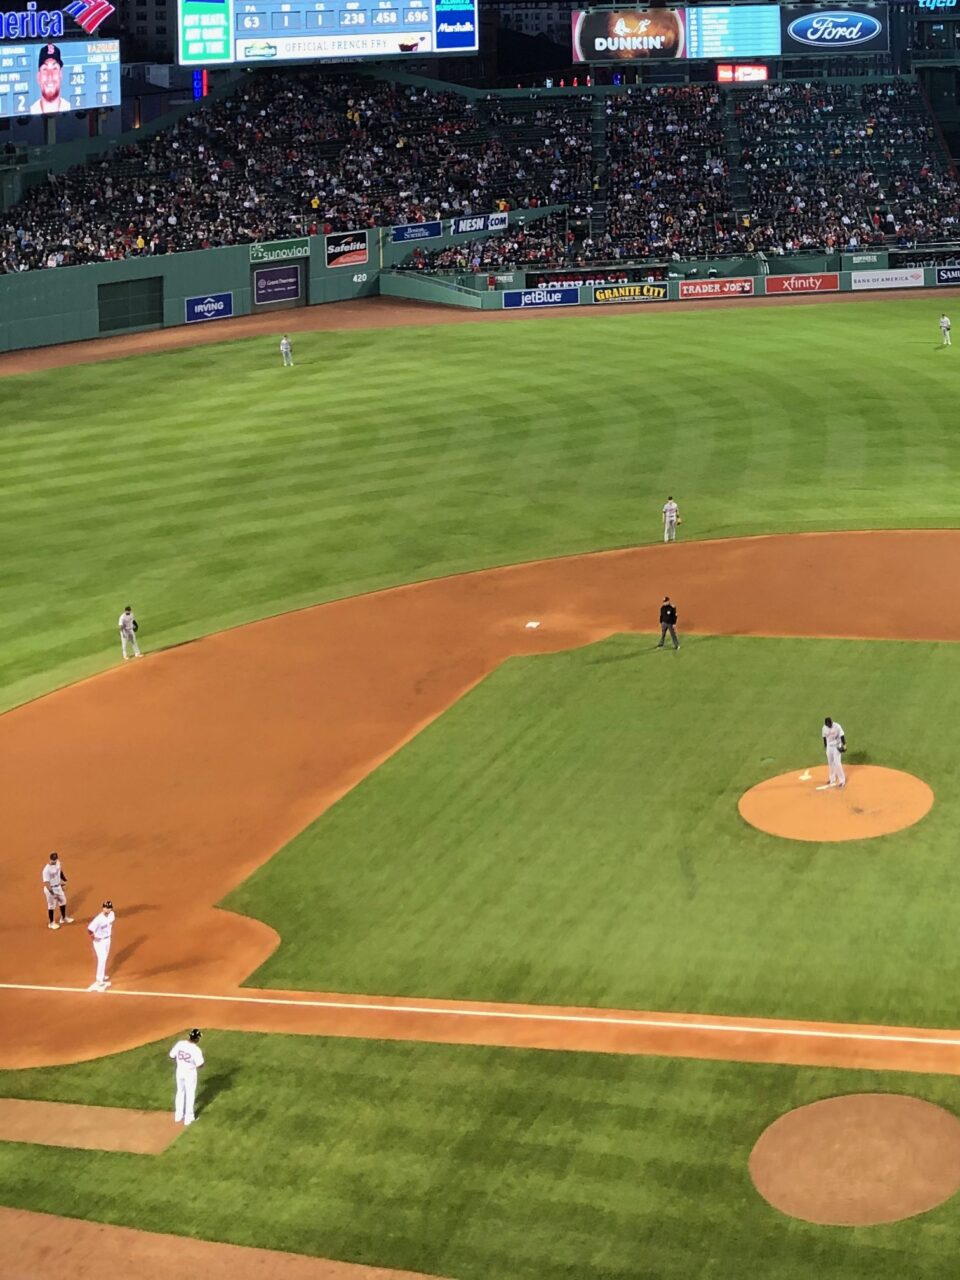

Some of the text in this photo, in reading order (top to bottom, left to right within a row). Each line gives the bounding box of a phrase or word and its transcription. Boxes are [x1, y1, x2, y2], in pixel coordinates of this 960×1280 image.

[244, 16, 260, 28] 63
[340, 13, 365, 25] .238
[372, 12, 397, 24] .458
[404, 11, 429, 23] .696
[437, 21, 474, 32] Marshalls
[806, 16, 863, 40] Ford
[285, 39, 388, 53] OFFICIAL FRENCH FRY
[594, 35, 666, 51] DUNKIN'
[18, 96, 25, 112] 2
[458, 217, 484, 233] NESN
[262, 246, 310, 260] sunovion
[327, 241, 366, 254] Safelite
[353, 273, 367, 283] 420
[782, 277, 823, 292] xfinity
[881, 275, 909, 283] AMERICA
[595, 284, 666, 301] GRANITE CITY
[682, 281, 751, 295] TRADER JOE'S
[521, 291, 563, 306] jetBlue
[194, 300, 224, 312] IRVING
[178, 1050, 191, 1063] 52
